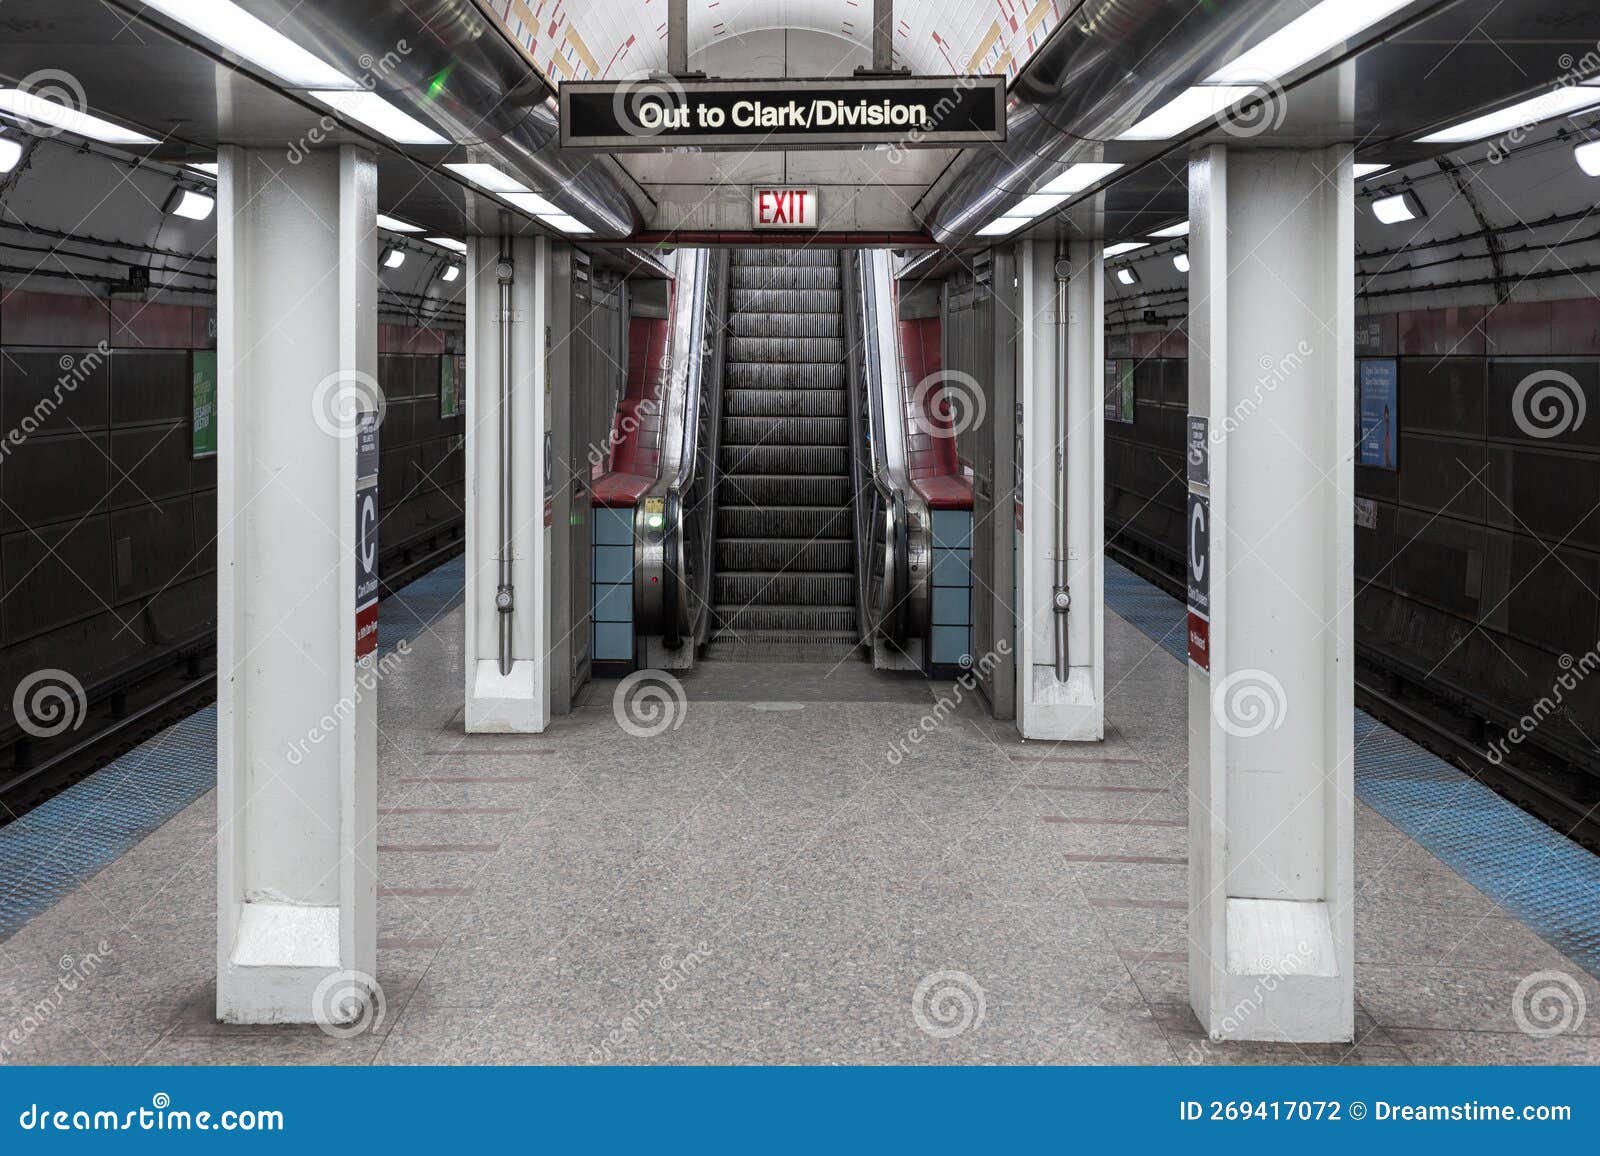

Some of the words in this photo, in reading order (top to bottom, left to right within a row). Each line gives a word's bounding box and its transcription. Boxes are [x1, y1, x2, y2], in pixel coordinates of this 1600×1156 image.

[639, 102, 690, 128] Out
[697, 103, 725, 127] to
[731, 99, 926, 128] Clark/Division
[759, 190, 807, 224] EXIT
[361, 495, 375, 573] C
[1191, 502, 1205, 582] C
